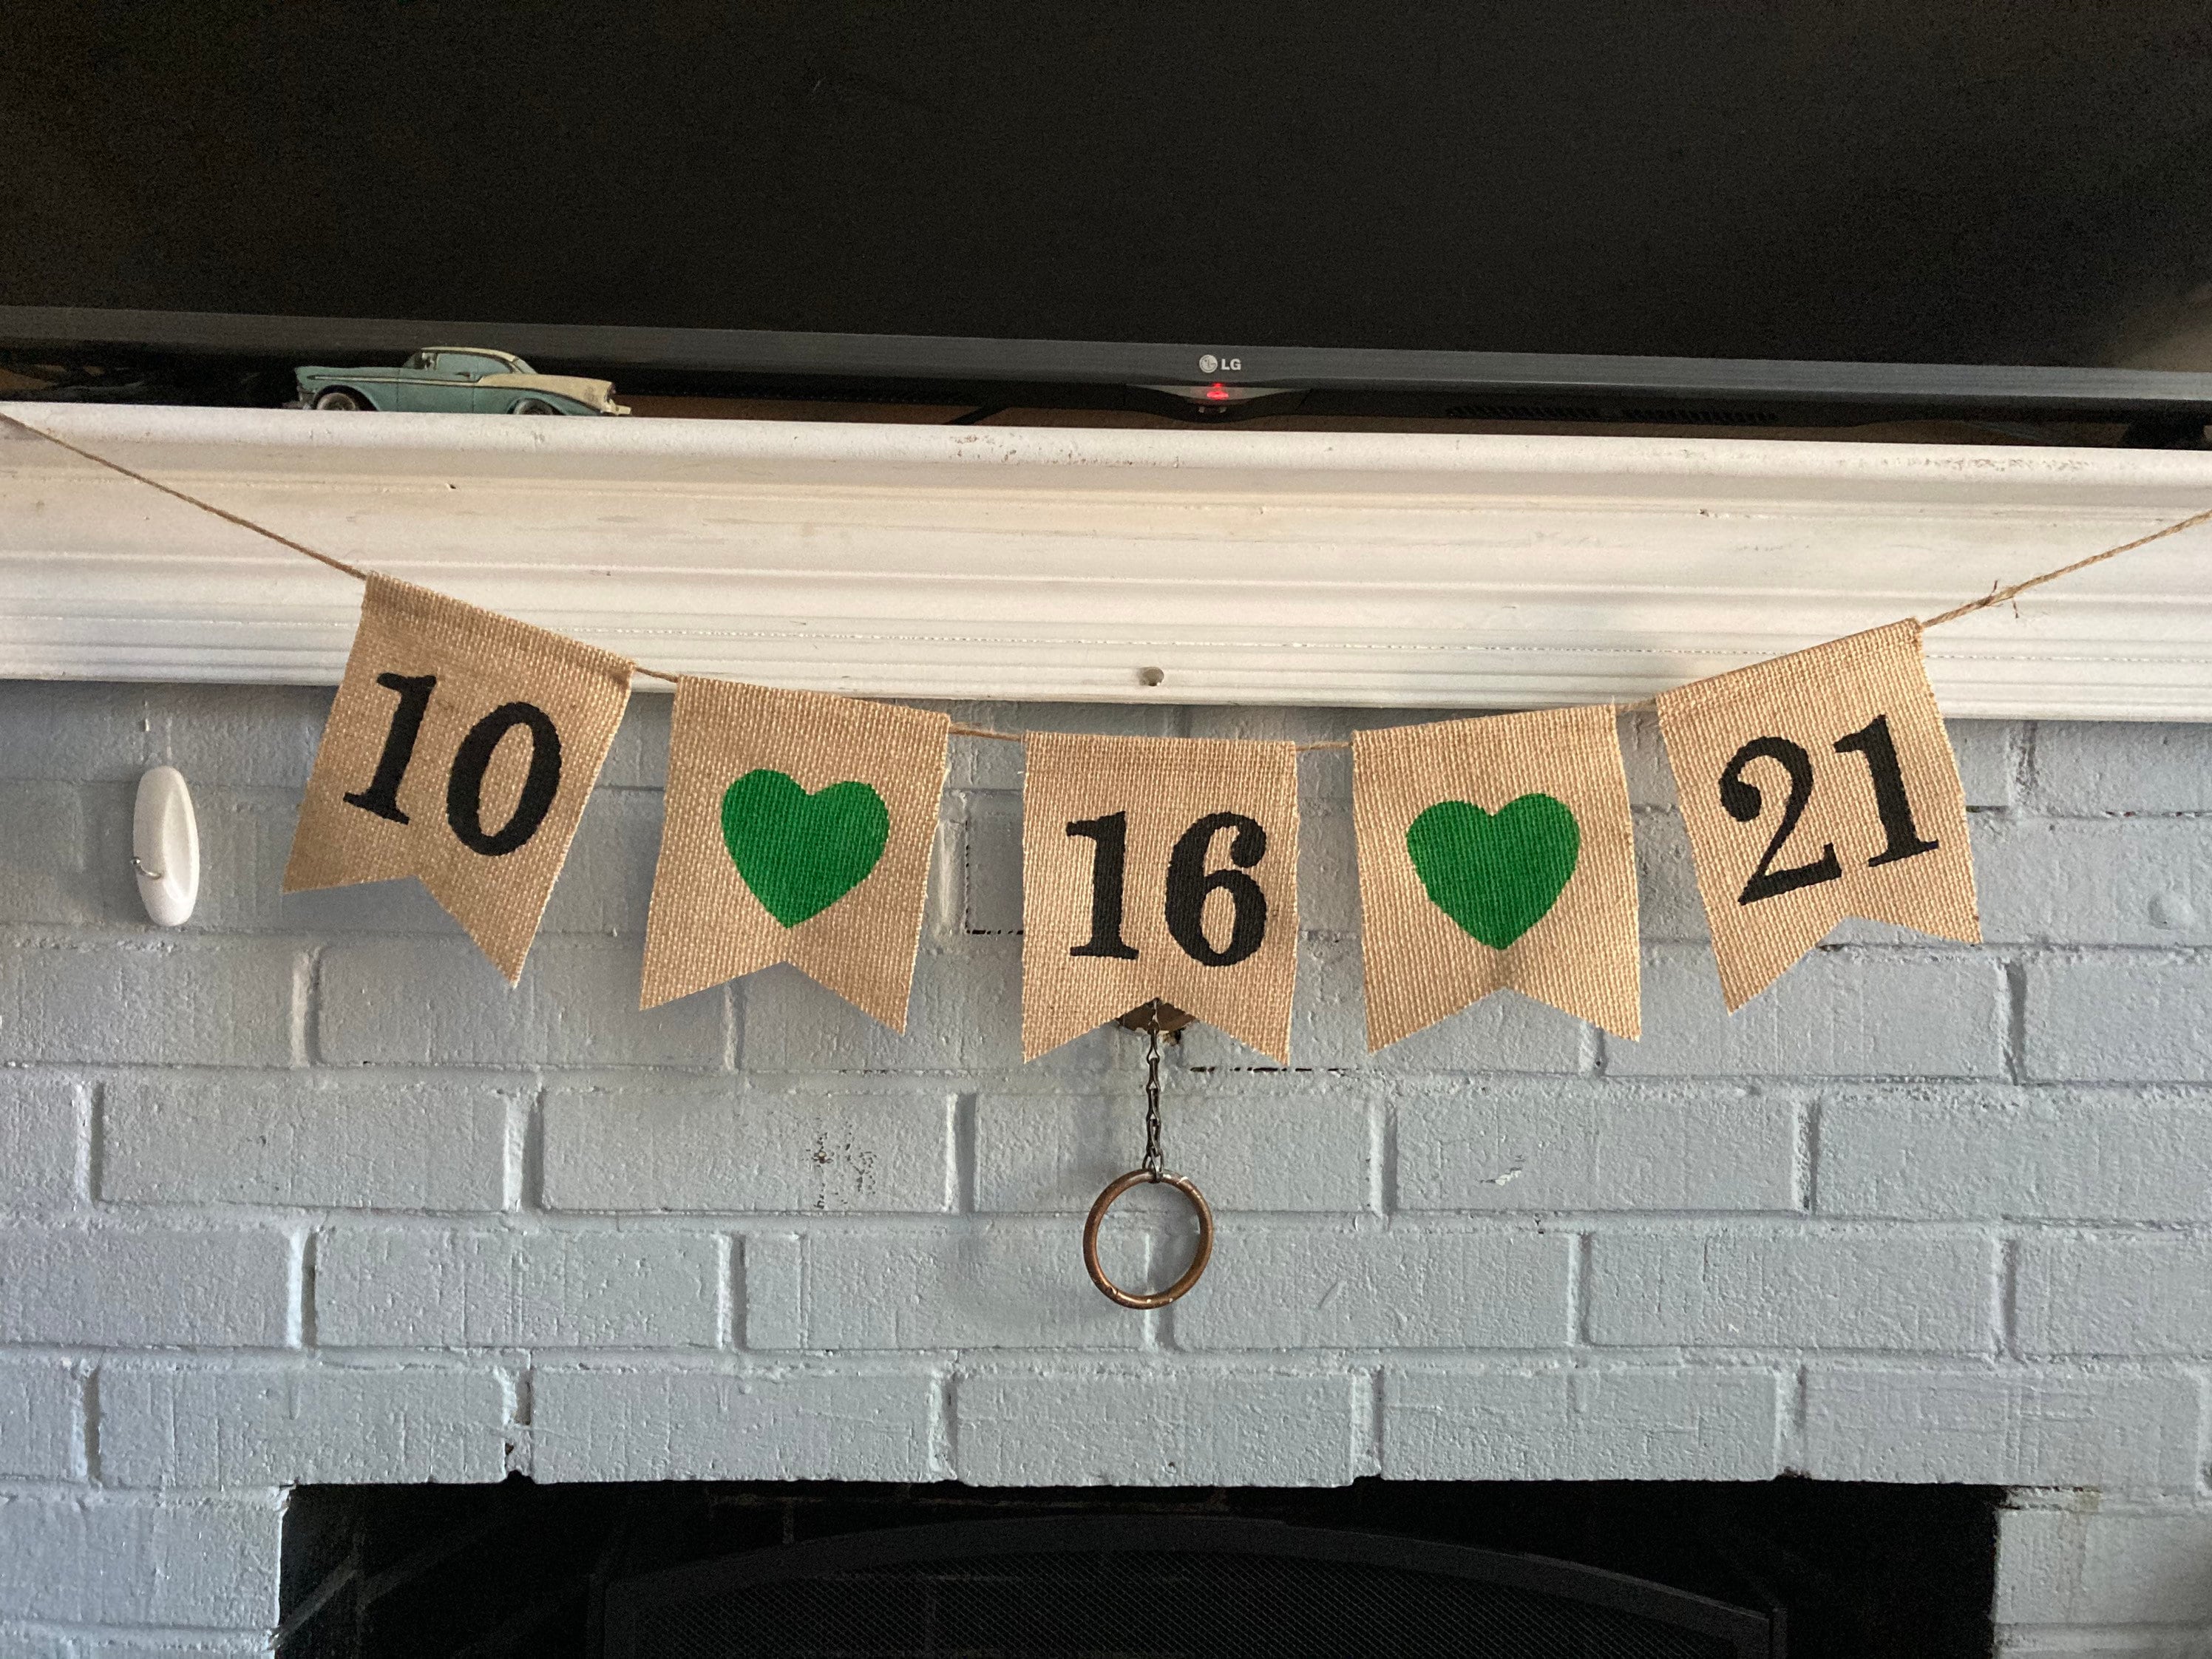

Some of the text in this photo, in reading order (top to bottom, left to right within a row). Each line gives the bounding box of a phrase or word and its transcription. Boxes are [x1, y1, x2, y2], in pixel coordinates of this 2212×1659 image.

[1221, 358, 1242, 370] LG
[342, 671, 563, 858] 10
[1717, 713, 1940, 907] 21
[1065, 810, 1268, 968] 16
